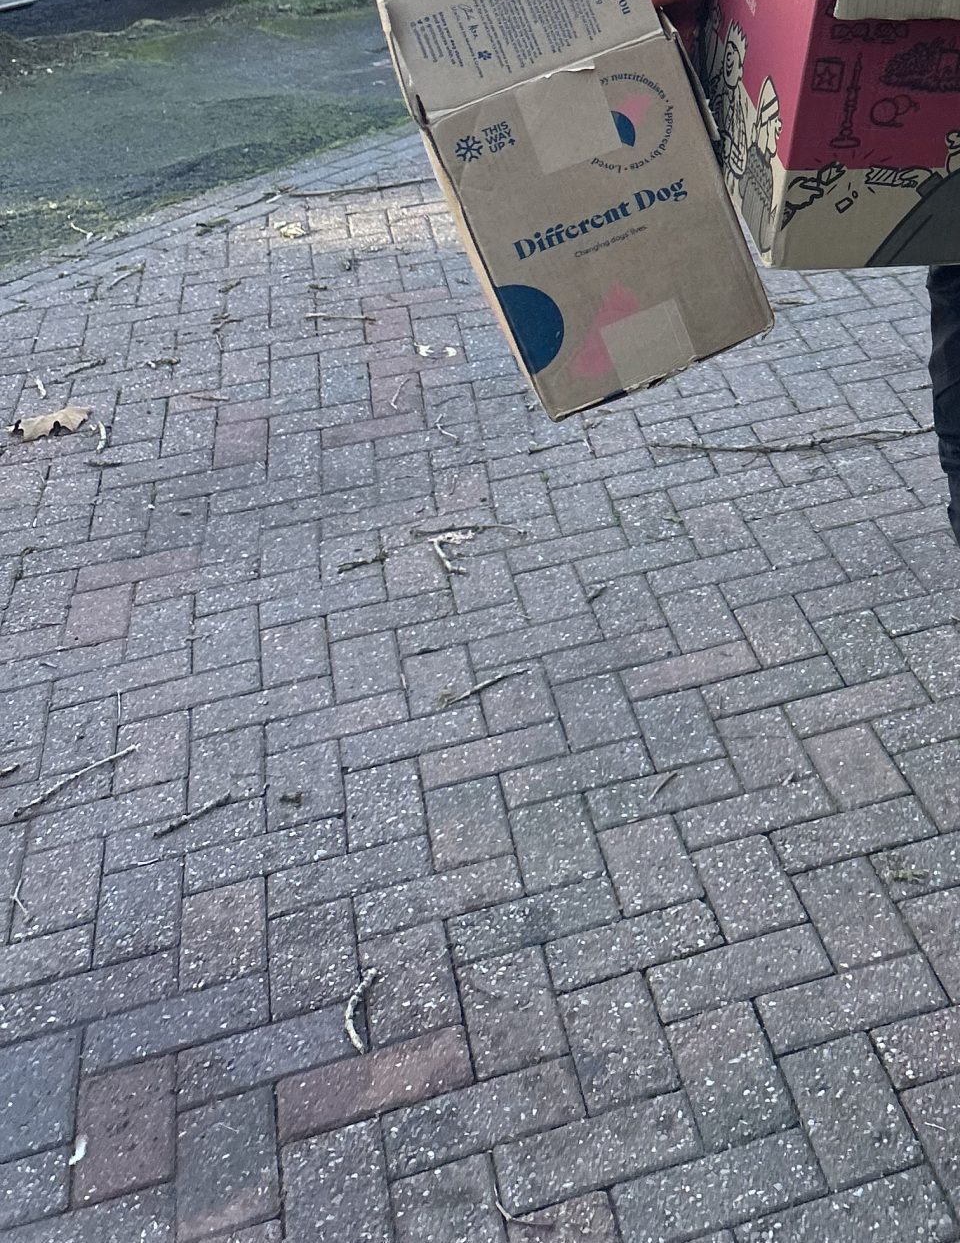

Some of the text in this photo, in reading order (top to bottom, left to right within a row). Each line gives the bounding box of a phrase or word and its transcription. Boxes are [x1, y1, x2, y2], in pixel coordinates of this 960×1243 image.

[611, 72, 666, 100] nutritionists
[658, 105, 674, 151] Approved
[481, 121, 509, 137] THIS
[485, 128, 512, 145] WAY
[489, 141, 506, 153] UP
[512, 178, 688, 261] Different Dog
[574, 240, 610, 258] Changing
